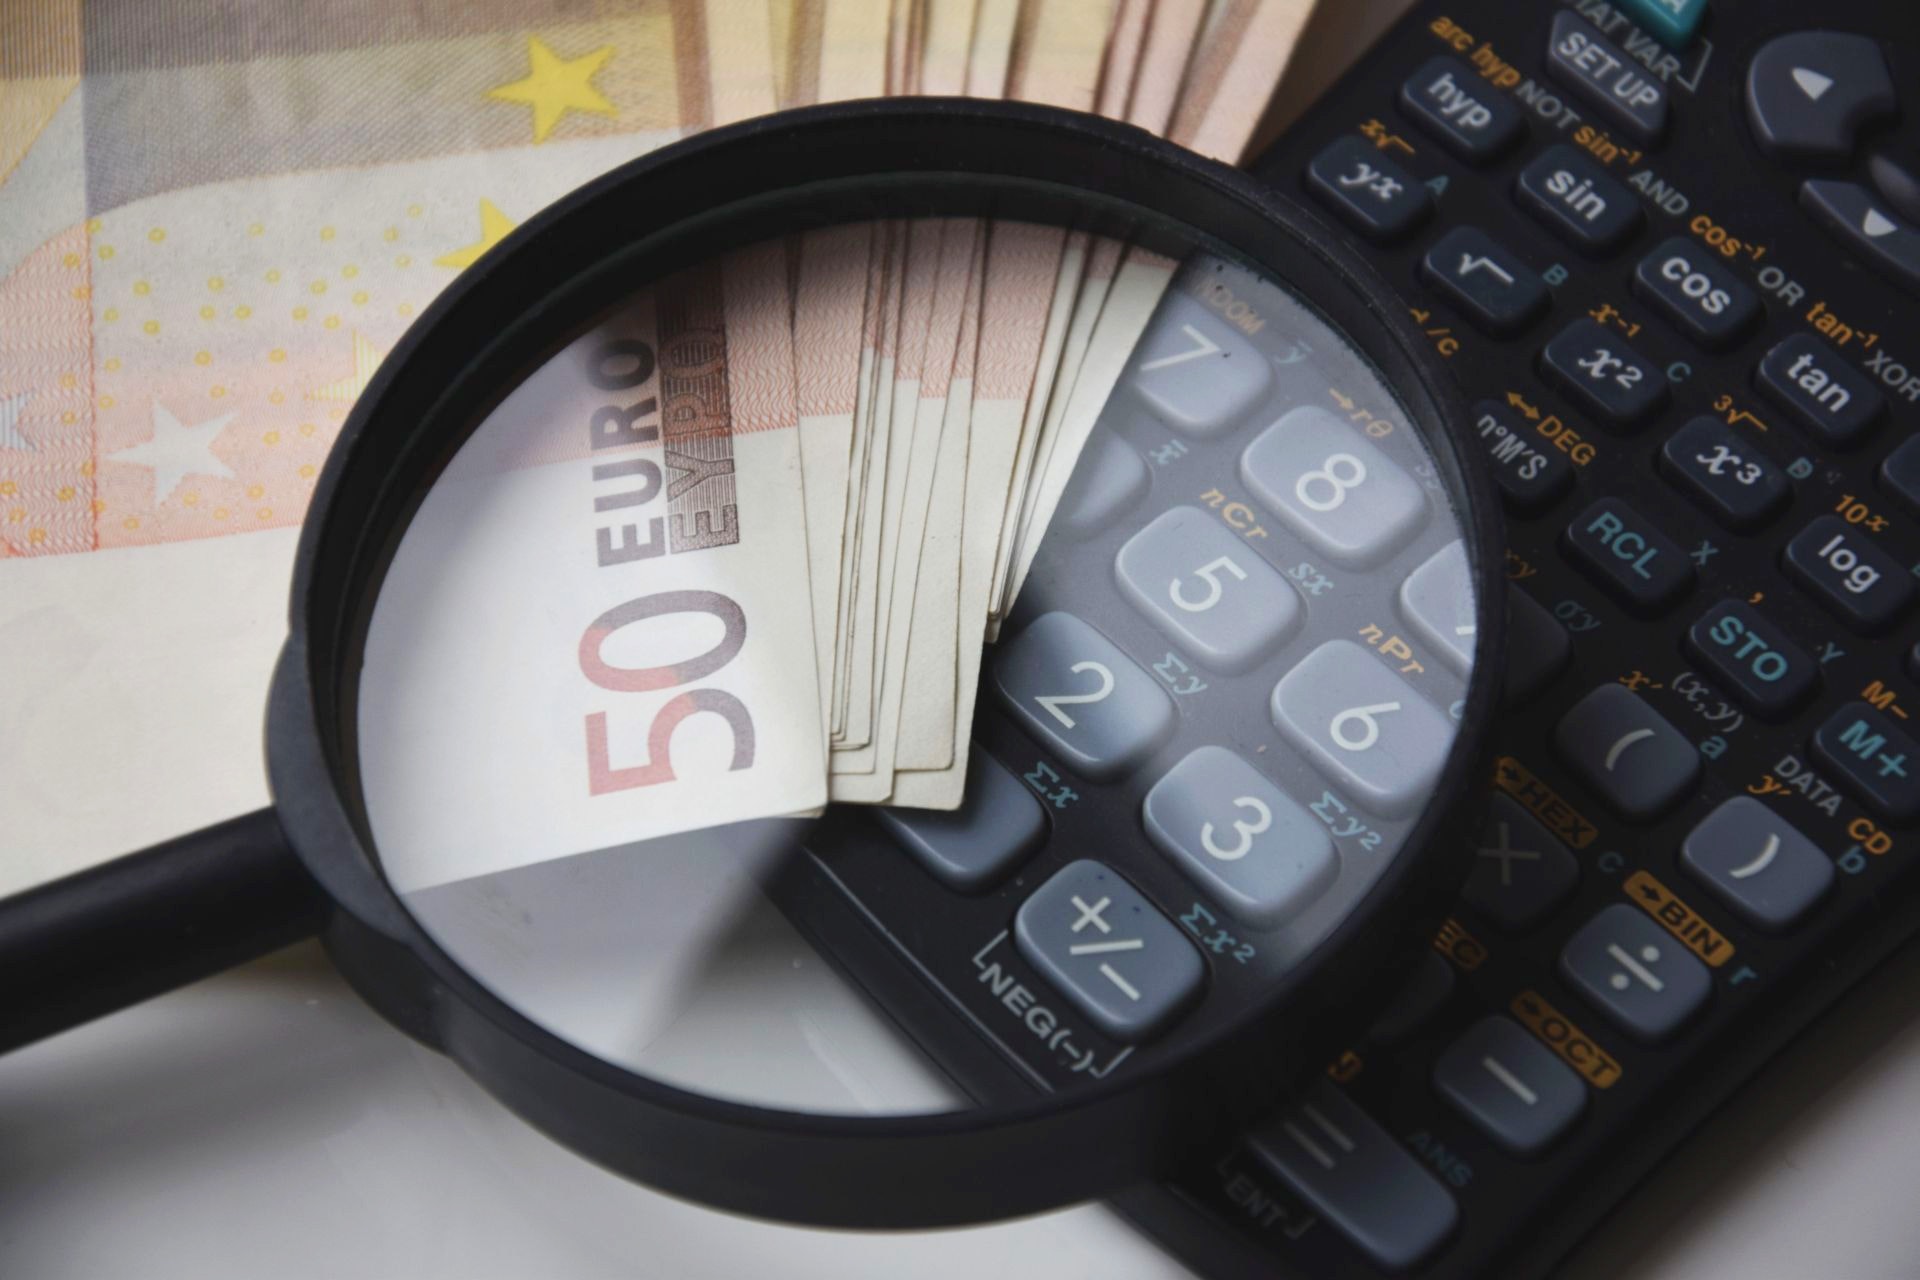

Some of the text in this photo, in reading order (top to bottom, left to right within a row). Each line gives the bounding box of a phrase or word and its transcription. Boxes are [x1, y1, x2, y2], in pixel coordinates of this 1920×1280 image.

[1428, 16, 1520, 87] arc hyp
[1558, 32, 1660, 108] SET UP
[1624, 27, 1680, 81] VAR
[1429, 73, 1492, 128] hyp
[1515, 80, 1580, 128] NOT
[1546, 170, 1607, 221] sin
[1629, 170, 1690, 215] AND
[1662, 257, 1731, 314] cos
[1758, 266, 1805, 307] OR
[1140, 325, 1222, 371] 7
[1864, 348, 1920, 402] XOR
[1787, 352, 1851, 412] tan
[1537, 415, 1597, 467] DEG
[1296, 453, 1367, 512] 8
[578, 339, 756, 797] 50 EURO
[1587, 511, 1659, 579] RCL
[1818, 534, 1881, 593] log
[1169, 556, 1248, 612] 5
[1709, 615, 1789, 681] STO
[1033, 661, 1114, 729] 2
[1330, 701, 1401, 752] 6
[1838, 719, 1908, 777] M+
[1774, 754, 1843, 817] DATA
[1201, 797, 1272, 861] 3
[1848, 817, 1893, 855] CD
[1658, 901, 1723, 956] BIN
[1541, 1016, 1618, 1078] OCT
